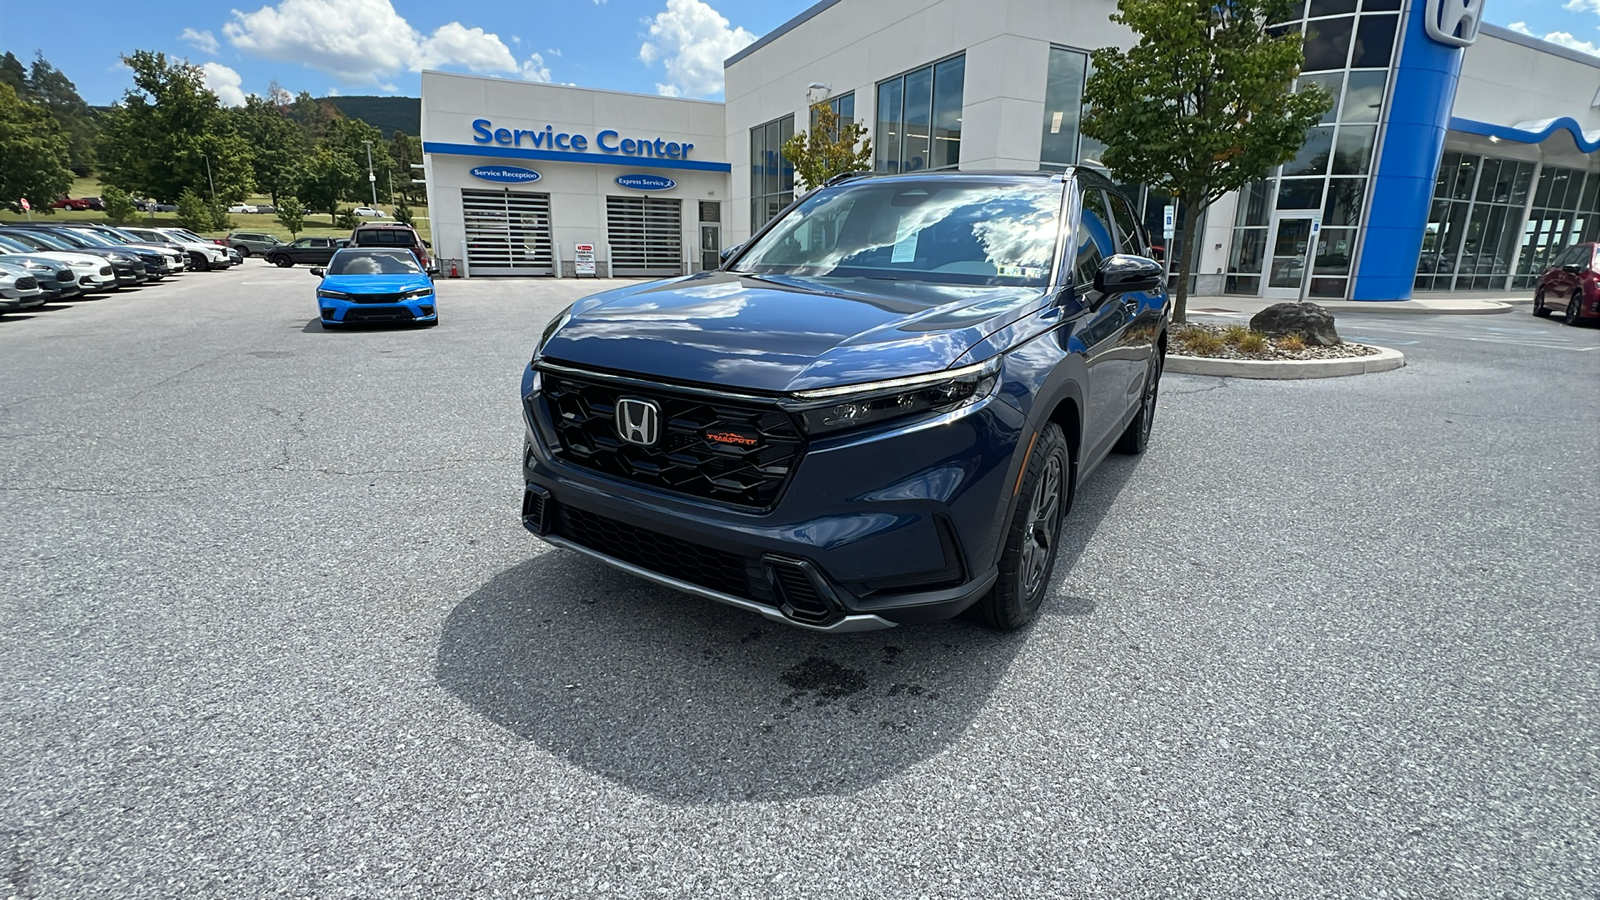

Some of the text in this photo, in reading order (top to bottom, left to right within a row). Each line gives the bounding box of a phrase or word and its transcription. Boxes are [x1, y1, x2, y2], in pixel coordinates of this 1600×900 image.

[472, 118, 694, 159] Service Center
[474, 169, 537, 179] Service Reception
[618, 177, 642, 185] Express
[707, 433, 757, 445] TRAILSPORT
